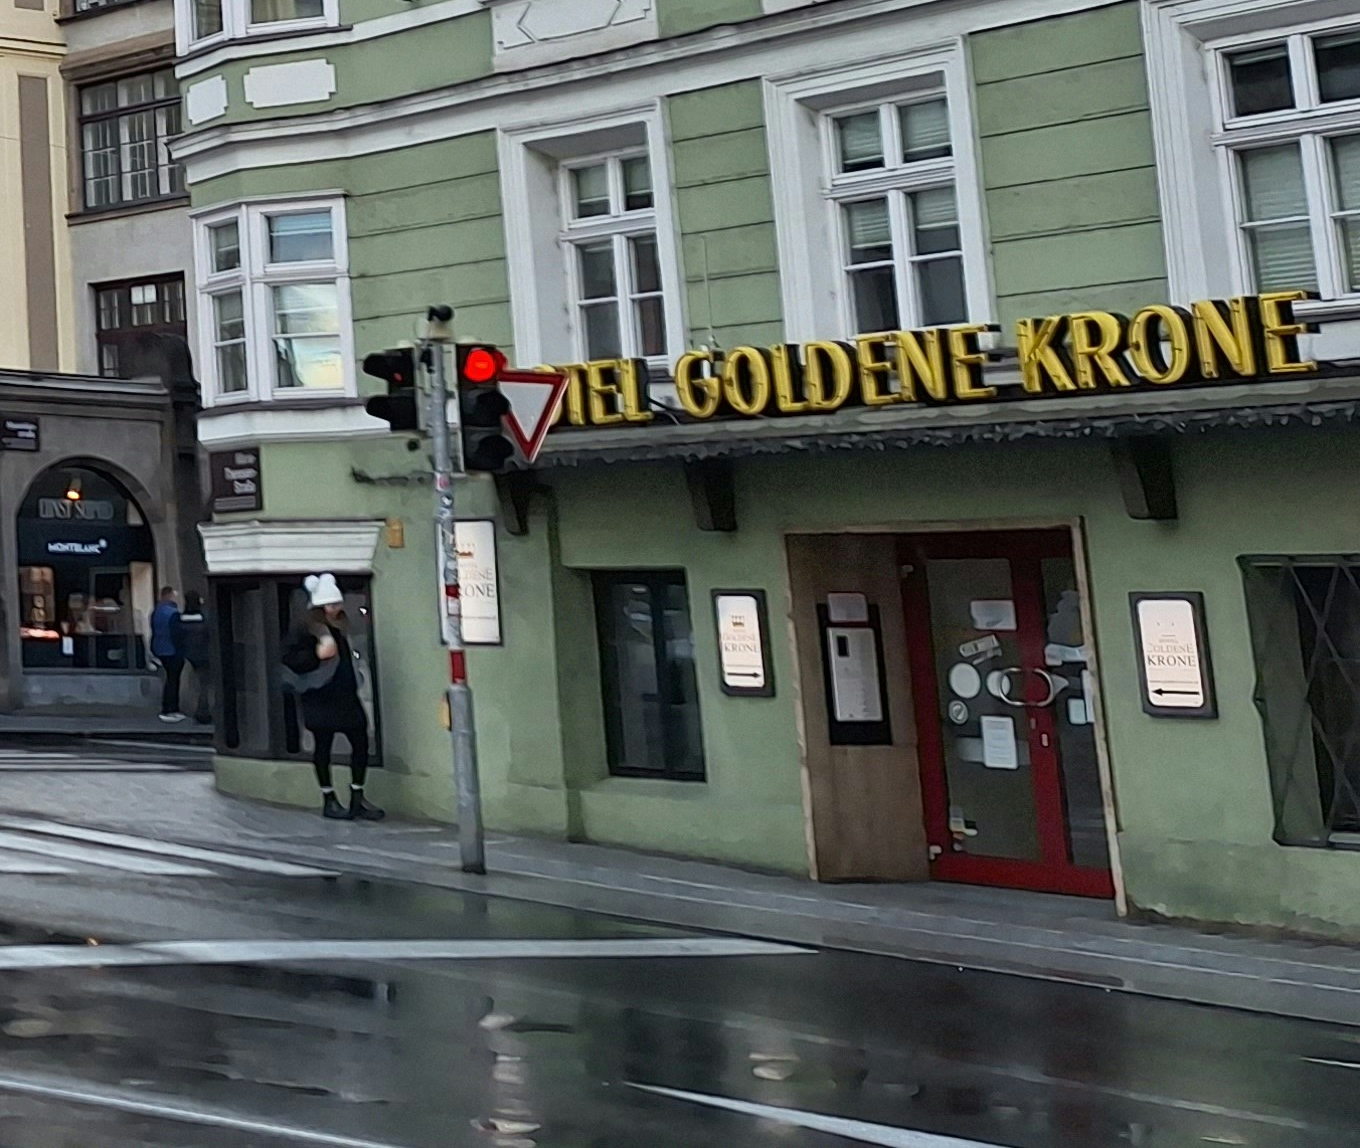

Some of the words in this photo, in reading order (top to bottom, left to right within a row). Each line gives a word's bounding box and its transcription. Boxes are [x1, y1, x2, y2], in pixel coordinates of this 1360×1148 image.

[675, 324, 997, 419] GOLDENE
[1016, 290, 1319, 393] KRONE
[1148, 655, 1196, 666] KRONE
